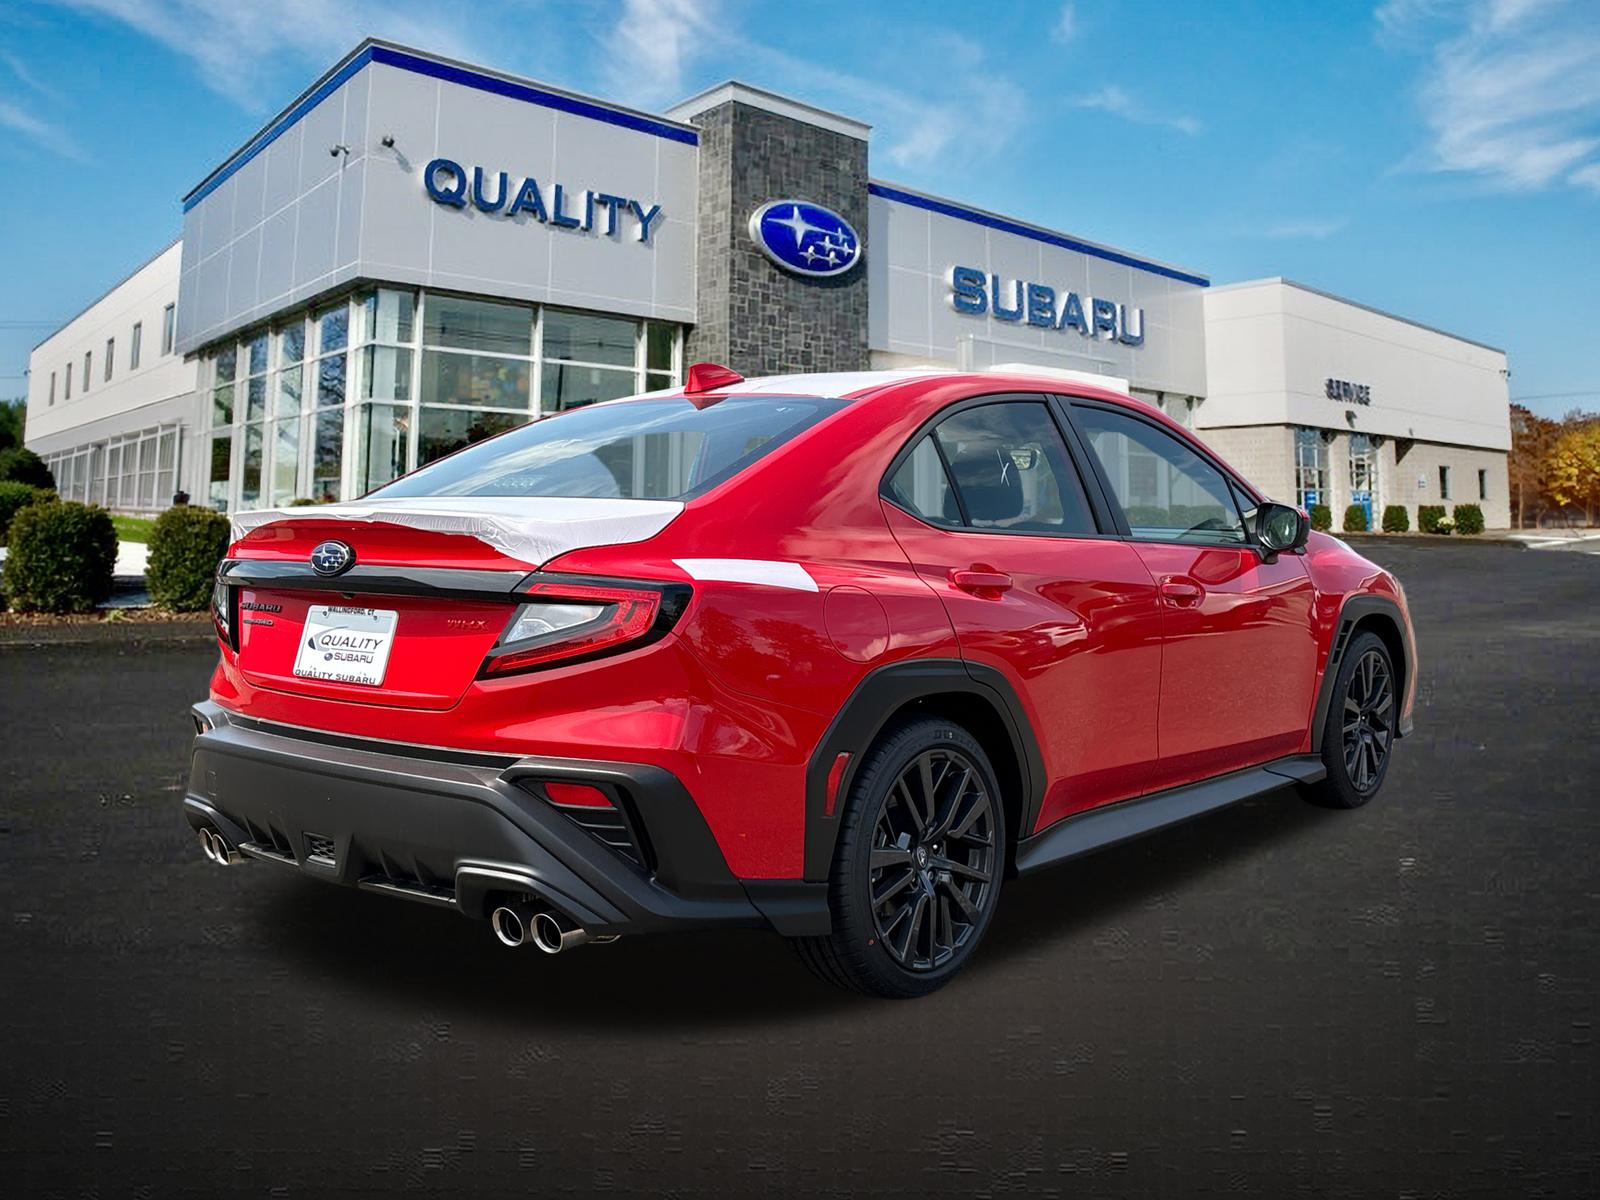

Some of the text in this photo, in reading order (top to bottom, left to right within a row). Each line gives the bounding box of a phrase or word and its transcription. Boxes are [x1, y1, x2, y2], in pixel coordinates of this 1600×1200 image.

[424, 158, 661, 242] QUALITY
[951, 265, 1145, 346] SUBARU
[1325, 378, 1370, 406] SERVICE
[241, 602, 282, 613] SUBARU
[321, 635, 383, 650] QUALITY
[334, 652, 374, 664] SUBARU
[295, 669, 376, 685] QUALITY SUBARU
